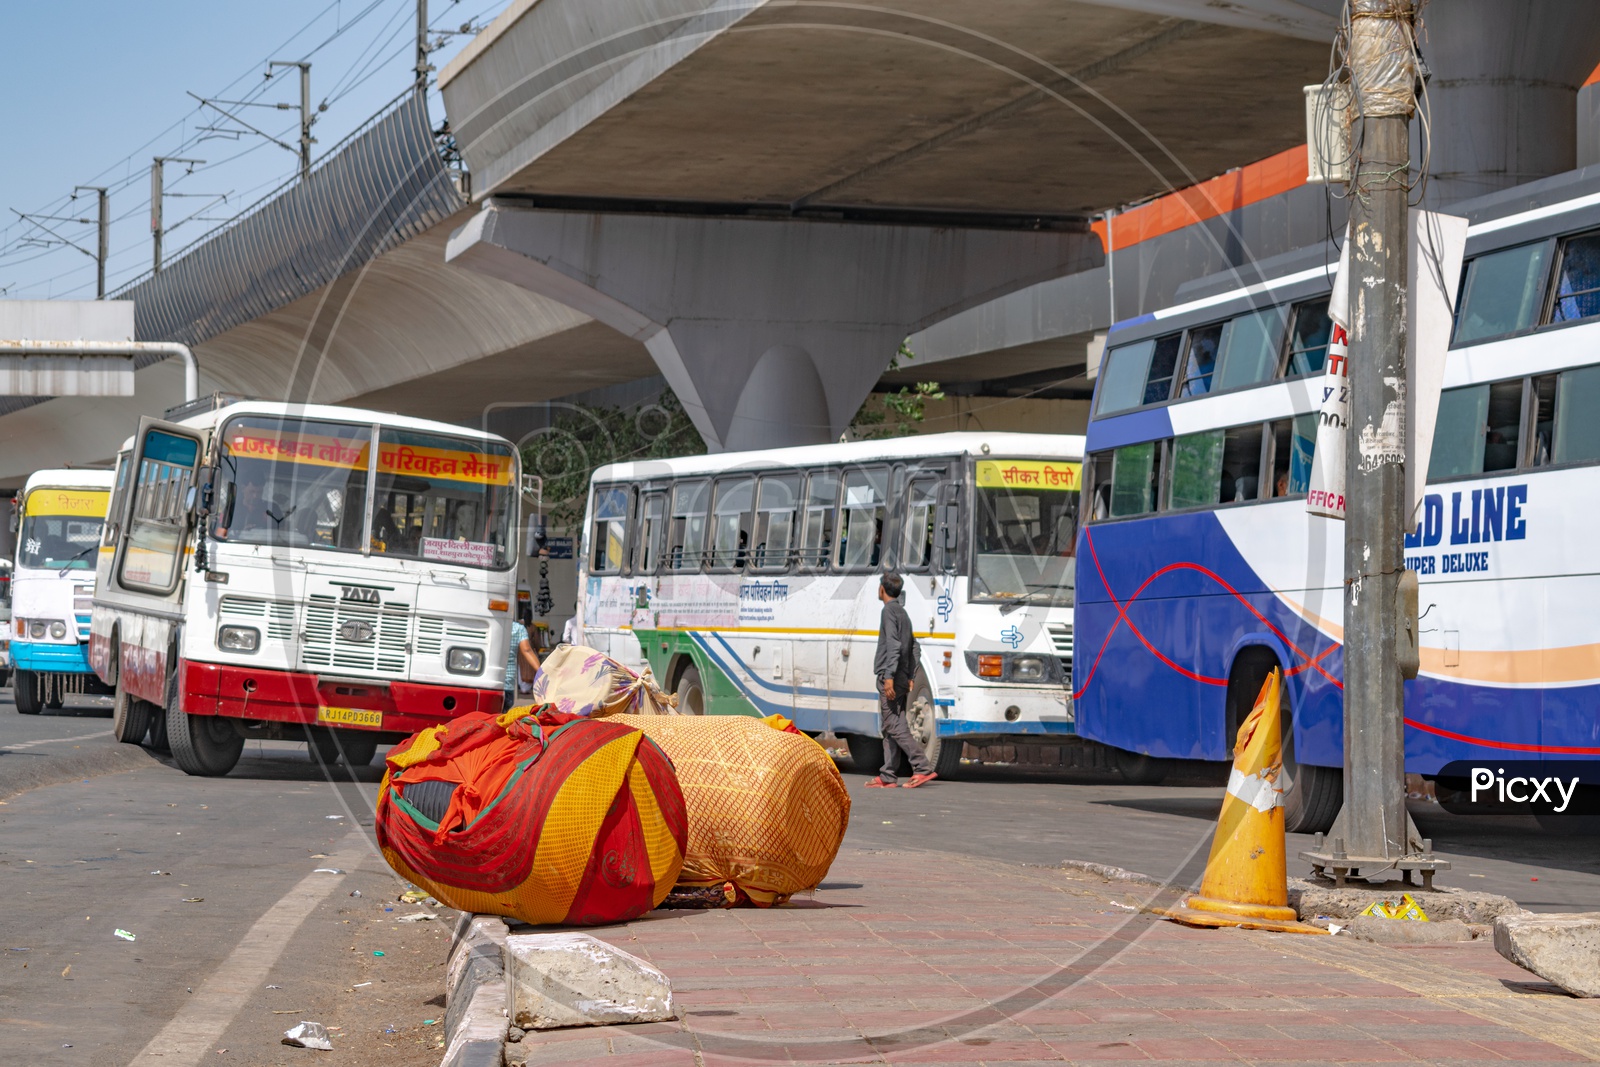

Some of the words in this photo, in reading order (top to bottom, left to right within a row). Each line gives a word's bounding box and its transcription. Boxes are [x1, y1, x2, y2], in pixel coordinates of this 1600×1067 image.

[232, 434, 314, 459] राजस्थान
[319, 438, 361, 464] लोक
[381, 446, 461, 476] परिवहन
[461, 453, 500, 480] सेवा
[1001, 466, 1040, 485] सीकर
[1043, 465, 1075, 486] डिपो
[57, 493, 95, 511] तिजारा
[1450, 483, 1528, 546] LINE
[424, 540, 447, 550] जयपुर
[1403, 555, 1436, 574] UPER
[1442, 551, 1489, 574] DELUXE
[341, 586, 381, 604] TATA
[325, 709, 381, 724] RJ14PD3668
